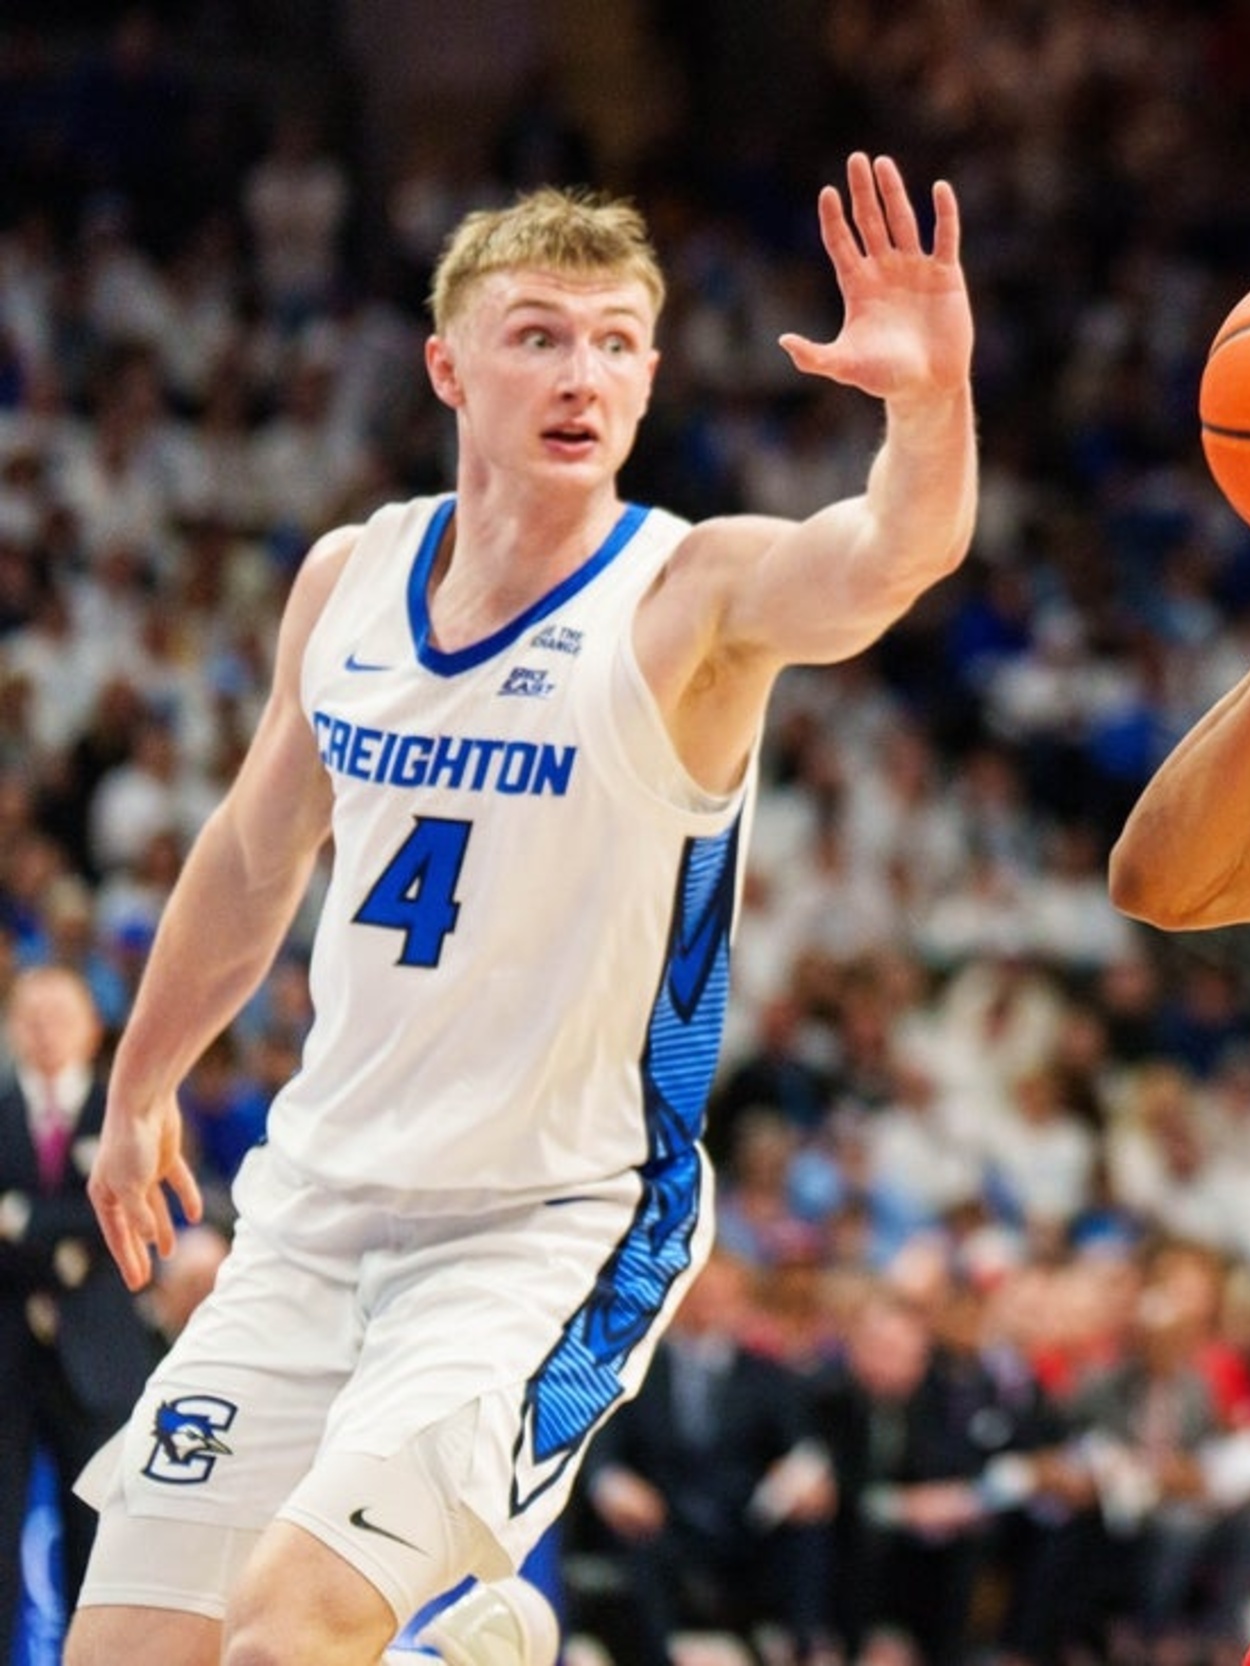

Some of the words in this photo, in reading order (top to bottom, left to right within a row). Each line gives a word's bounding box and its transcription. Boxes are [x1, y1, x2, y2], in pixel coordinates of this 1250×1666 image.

[530, 636, 583, 656] CHANGE
[497, 678, 556, 697] EAST
[314, 711, 579, 797] CREIGHTON
[351, 814, 474, 969] 4
